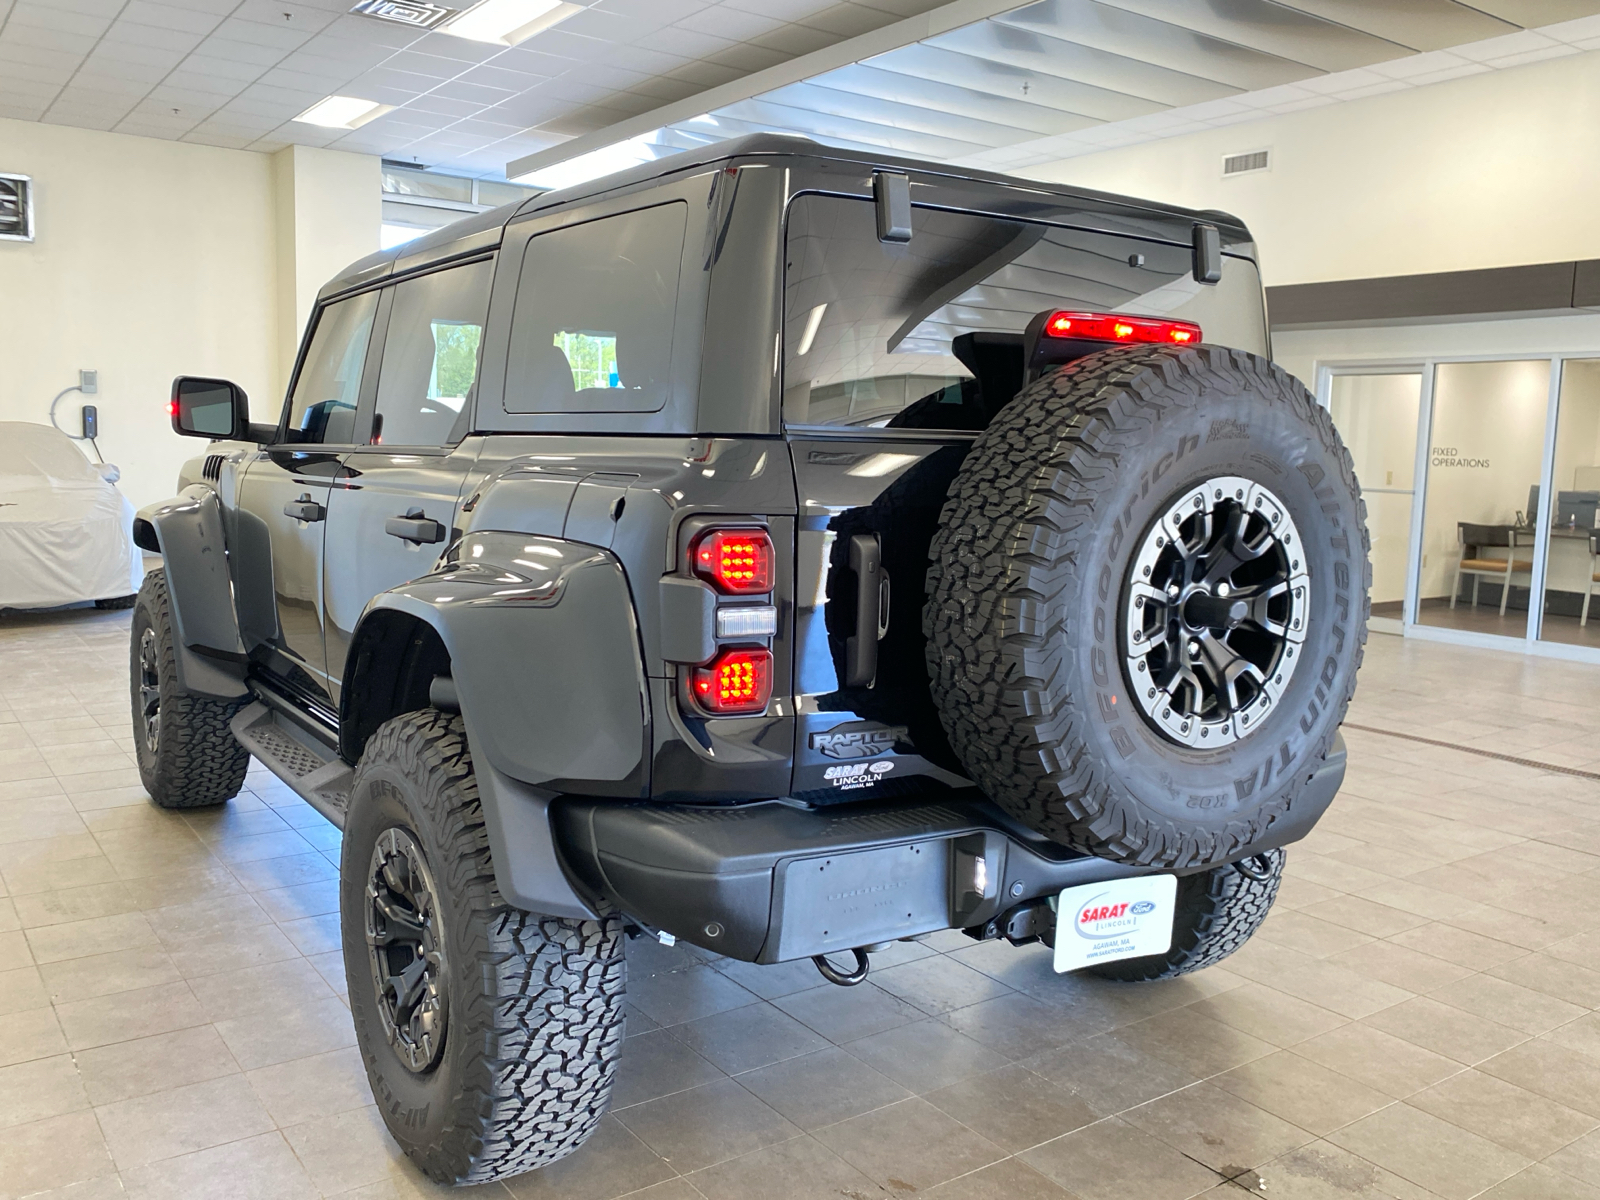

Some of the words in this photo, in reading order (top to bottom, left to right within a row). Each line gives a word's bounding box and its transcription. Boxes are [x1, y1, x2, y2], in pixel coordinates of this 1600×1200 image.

[1432, 447, 1458, 457] FIXED
[1432, 457, 1490, 468] OPERATIONS
[812, 725, 910, 752] RAPTOR
[824, 762, 869, 779] SARAT
[833, 773, 882, 786] LINCOLN
[841, 781, 865, 790] AGAWAM,
[1080, 902, 1129, 923] SARAT
[1101, 919, 1131, 929] LINCOLN
[1093, 940, 1120, 951] AGAWAM,
[1086, 945, 1135, 959] WWW.SARATFORD.COM
